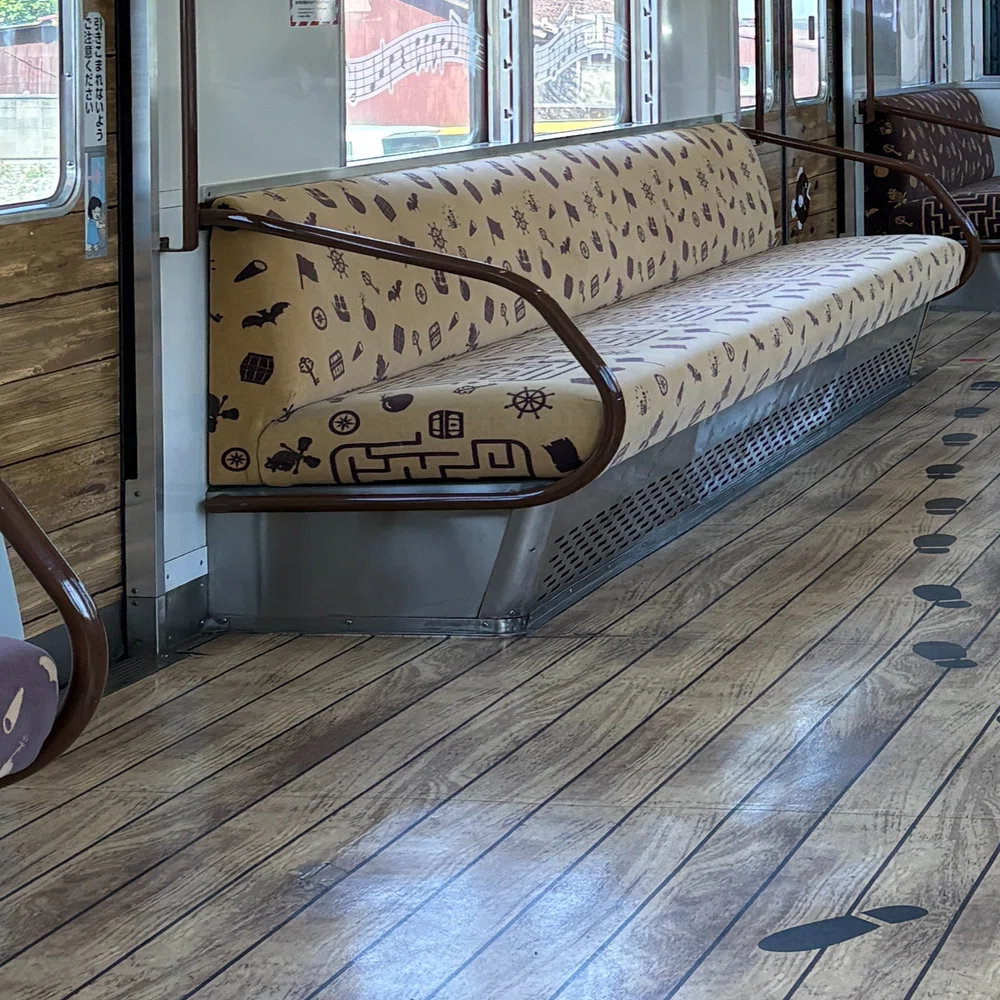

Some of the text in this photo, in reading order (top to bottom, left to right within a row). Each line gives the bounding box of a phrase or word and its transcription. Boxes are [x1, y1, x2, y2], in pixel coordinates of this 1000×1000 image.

[83, 16, 94, 114] ご注意ください
[94, 16, 104, 142] 引きこまれないよう
